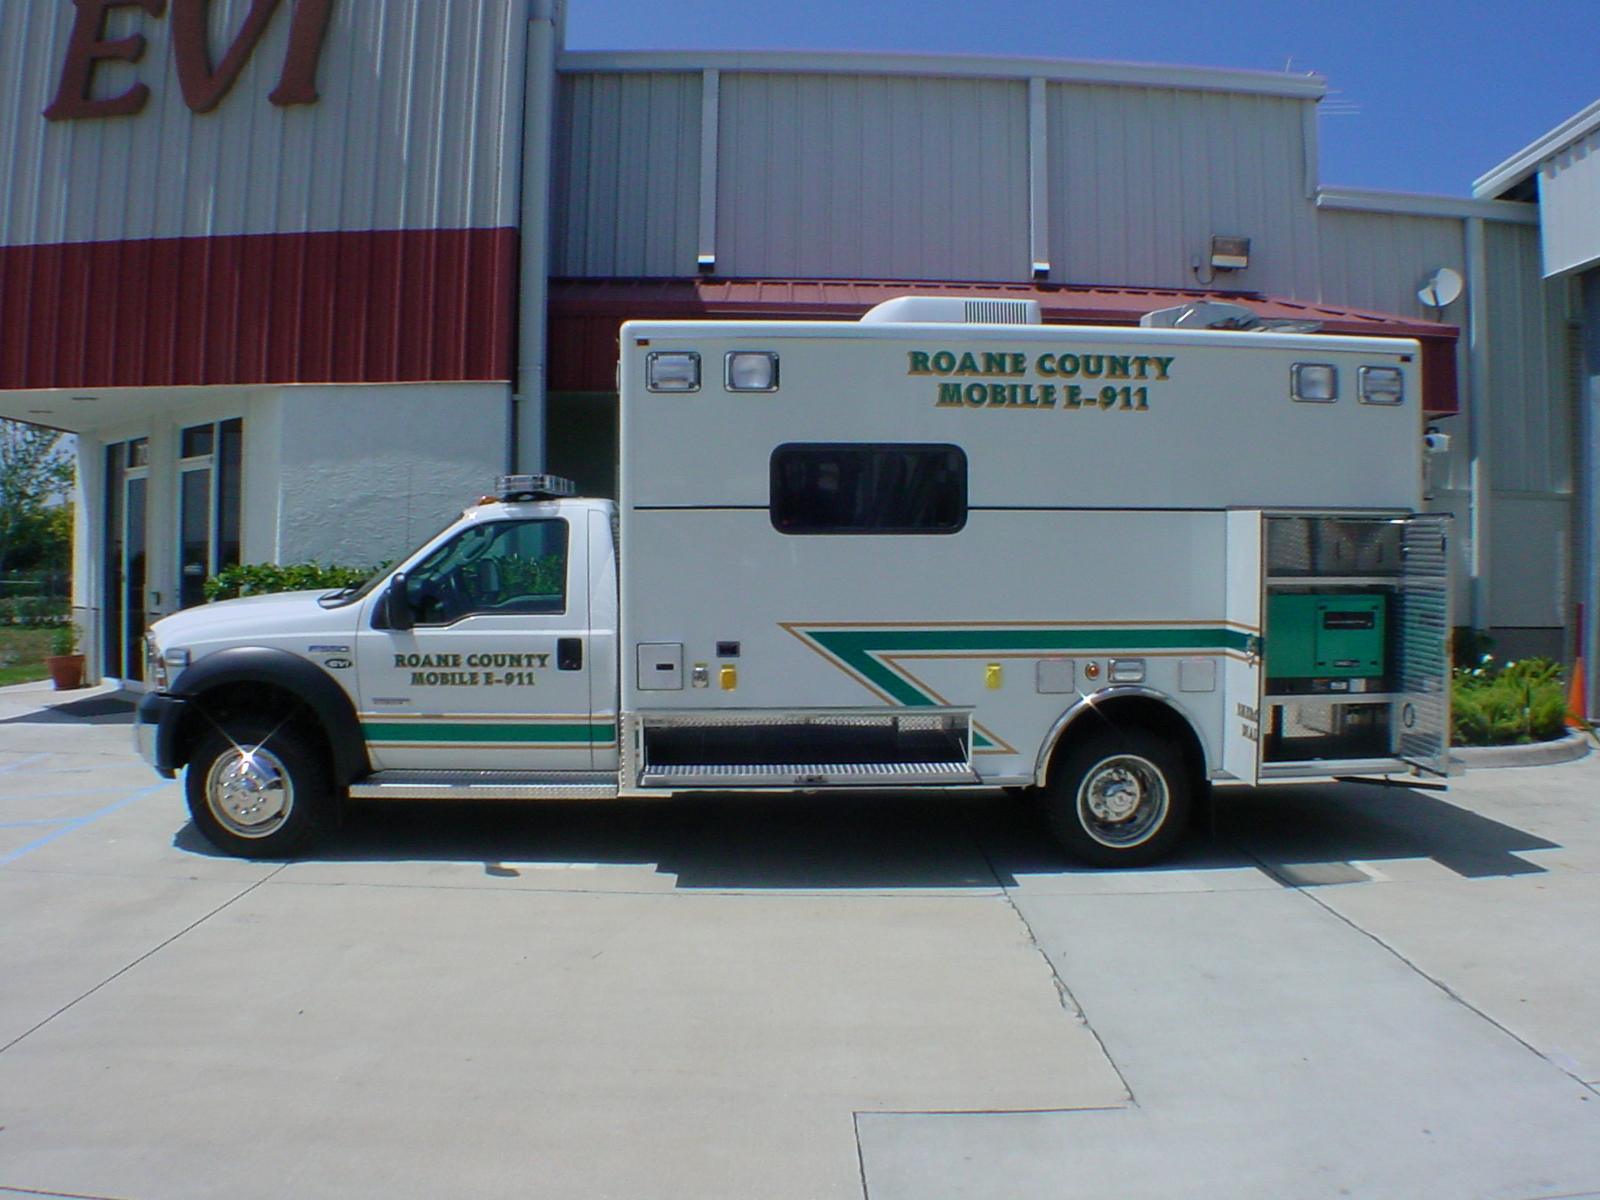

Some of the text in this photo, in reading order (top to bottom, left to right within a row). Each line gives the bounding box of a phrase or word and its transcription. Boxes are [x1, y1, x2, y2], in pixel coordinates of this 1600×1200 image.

[42, 0, 333, 121] EVI
[907, 350, 1176, 381] ROANE COUNTY
[935, 382, 1152, 411] MOBILE E-911
[394, 653, 550, 668] ROANE COUNTY
[410, 671, 535, 686] MOBILE E-911
